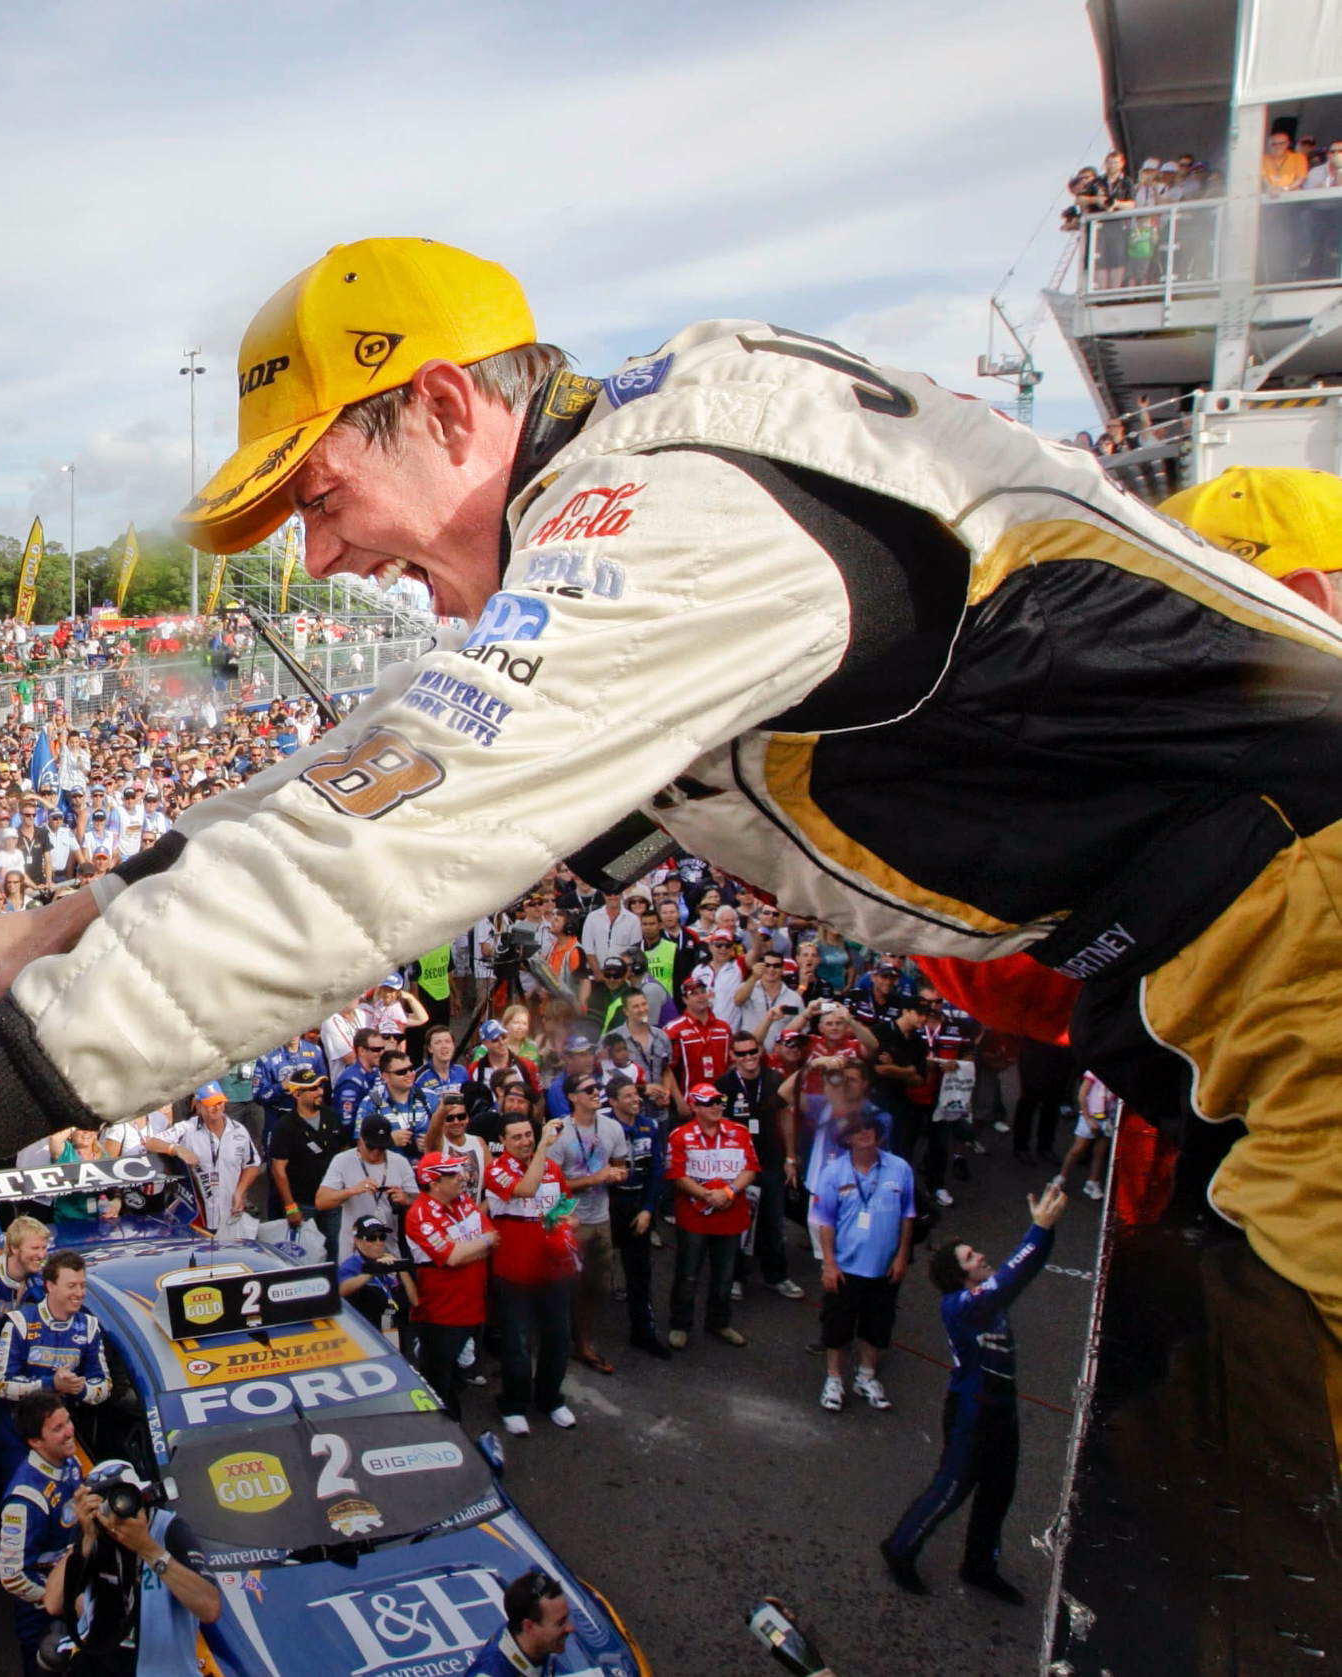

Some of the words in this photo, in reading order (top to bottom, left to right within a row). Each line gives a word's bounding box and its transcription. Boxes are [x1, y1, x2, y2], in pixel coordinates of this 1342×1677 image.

[239, 355, 290, 399] LOP
[460, 645, 544, 687] and
[418, 669, 513, 726] WAVERLEY
[407, 690, 443, 723] ORK
[447, 704, 498, 748] LIFTS
[1053, 922, 1136, 979] URTNEY
[199, 1173, 213, 1199] BEAM
[185, 1304, 223, 1318] GOLD
[240, 1280, 262, 1316] 2
[226, 1337, 348, 1367] DUNLOP
[227, 1358, 281, 1375] SUPER
[180, 1362, 398, 1425] FORD
[146, 1405, 166, 1456] TEAC
[222, 1459, 267, 1479] XXXX
[310, 1432, 359, 1500] 2
[217, 1474, 287, 1503] GOLD
[208, 1547, 280, 1566] awrence
